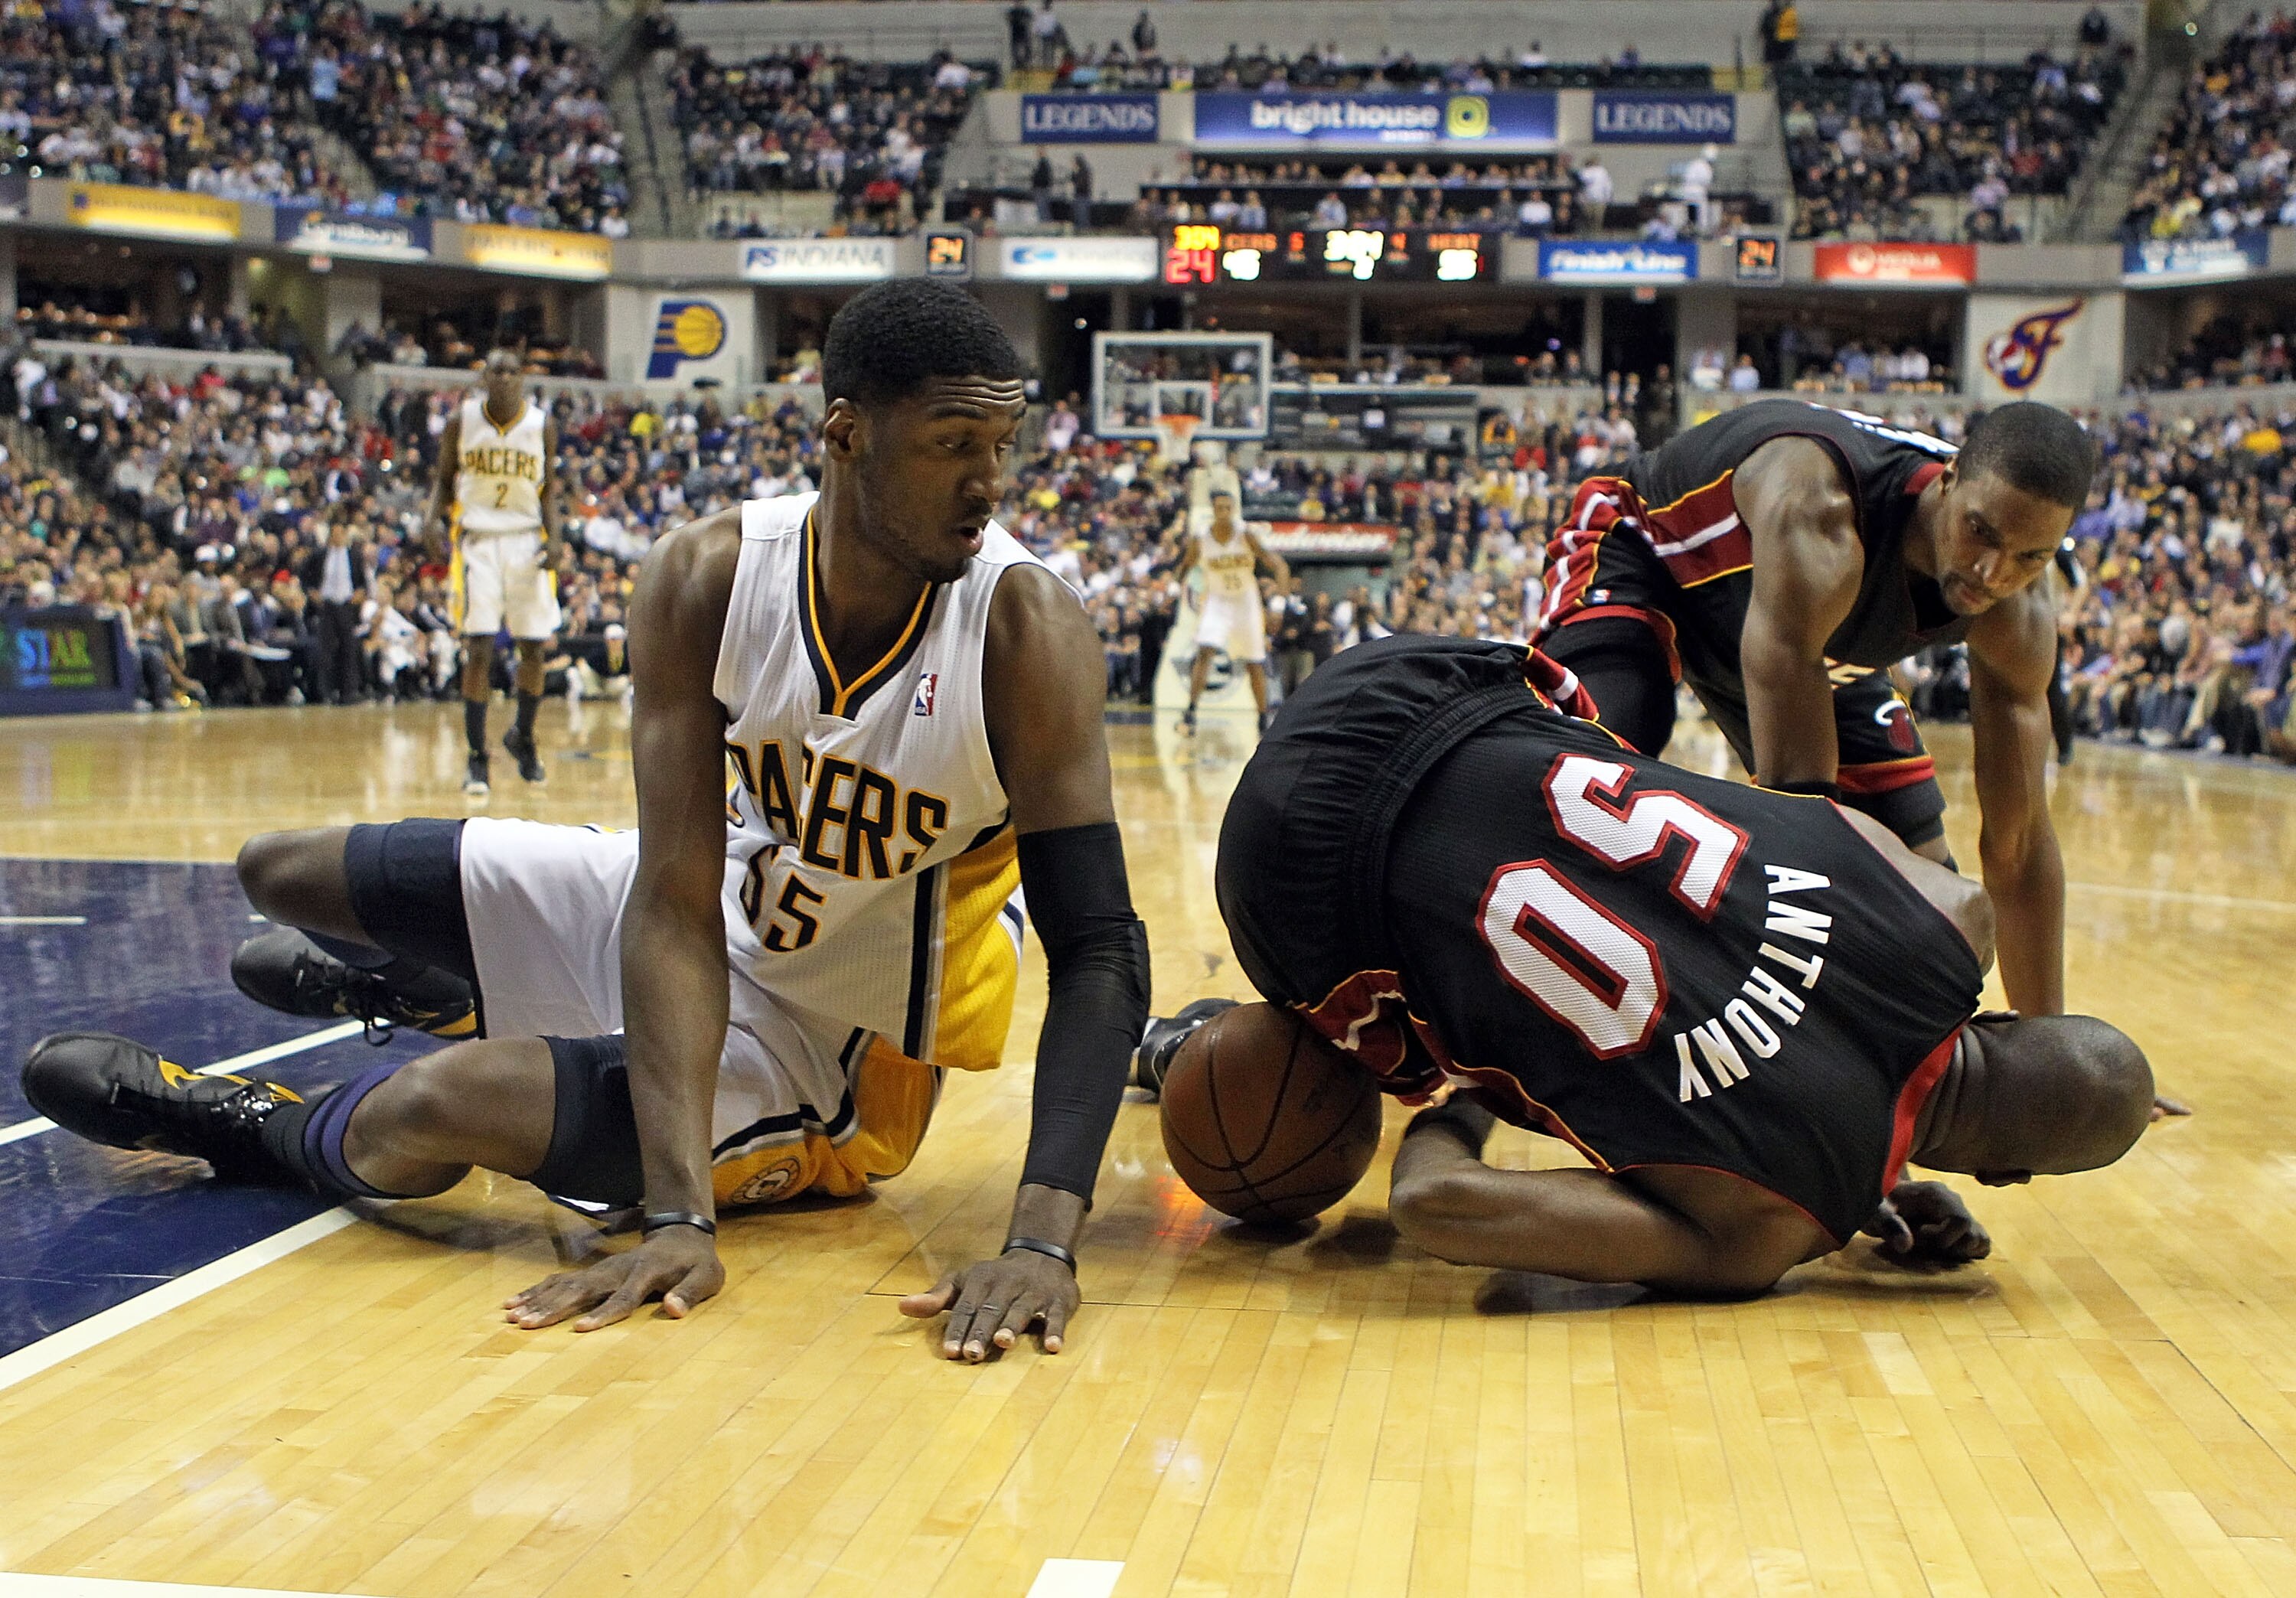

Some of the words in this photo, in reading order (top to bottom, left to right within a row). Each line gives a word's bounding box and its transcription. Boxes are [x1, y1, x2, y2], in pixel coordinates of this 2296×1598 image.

[1026, 103, 1155, 132] LEGENDS
[1251, 100, 1342, 135] bright
[1346, 100, 1440, 129] house
[1597, 103, 1731, 132] LEGENDS
[784, 246, 885, 268] INDIANA
[929, 237, 964, 263] 24
[1740, 239, 1776, 266] 24
[1166, 249, 1215, 283] 24
[465, 448, 536, 481] PACERS
[494, 482, 509, 508] 2
[1476, 752, 1750, 1061] 50
[1675, 864, 1832, 1102] ANTHONY
